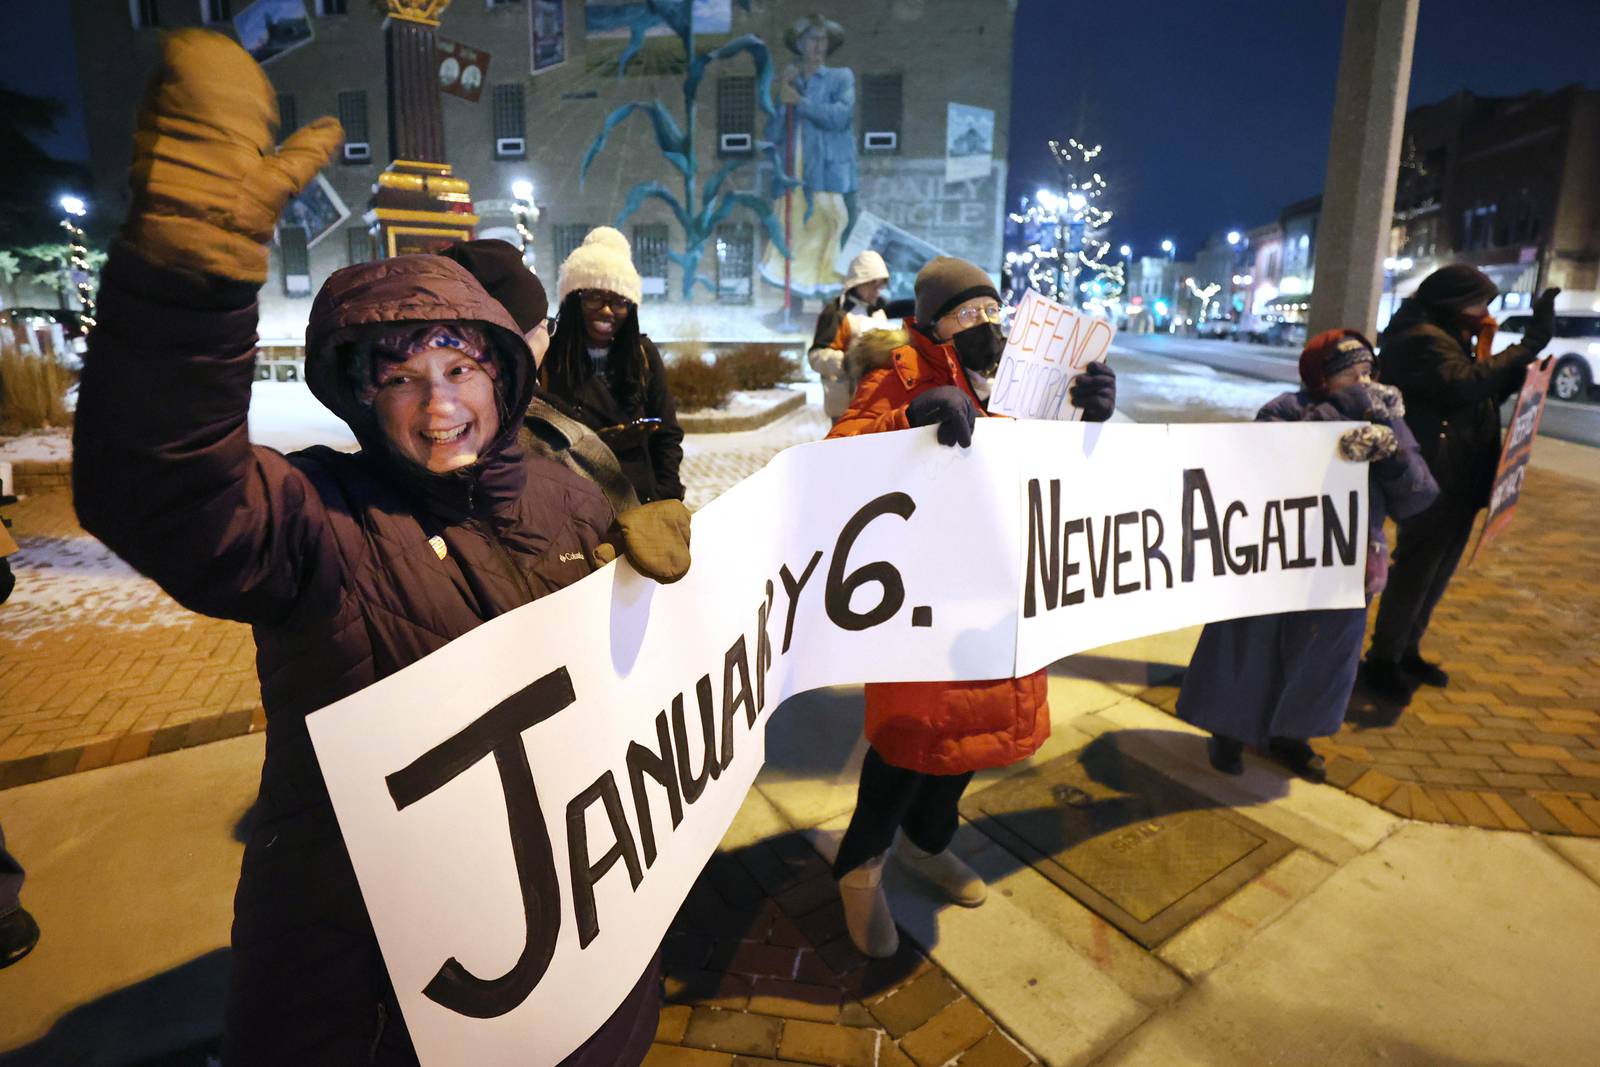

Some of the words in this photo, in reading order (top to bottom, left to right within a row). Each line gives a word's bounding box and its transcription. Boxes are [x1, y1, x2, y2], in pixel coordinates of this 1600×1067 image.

[1008, 294, 1112, 370] DEFEND
[385, 551, 823, 1019] JANUARY
[825, 492, 932, 631] 6.
